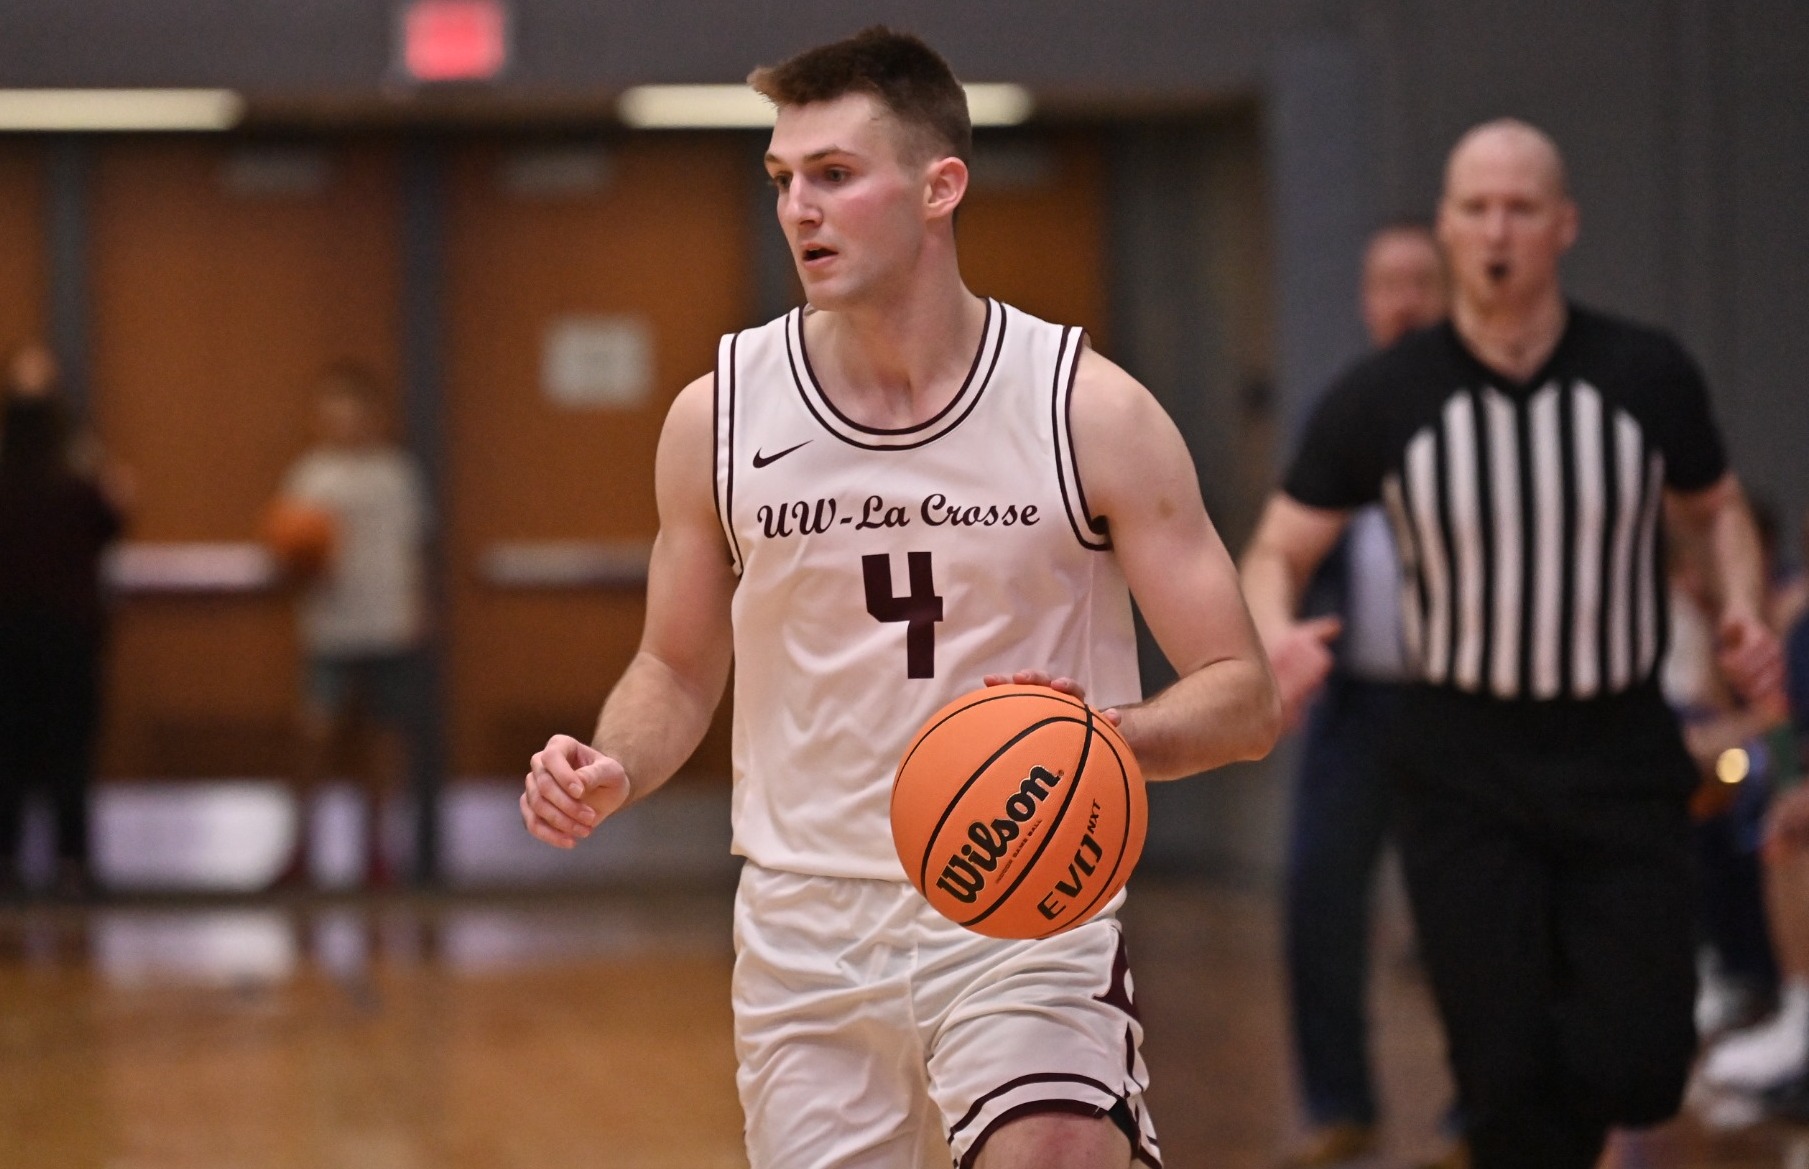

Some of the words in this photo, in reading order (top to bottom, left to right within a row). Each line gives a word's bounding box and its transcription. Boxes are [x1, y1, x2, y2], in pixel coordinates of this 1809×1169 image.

[757, 495, 910, 539] UW-La
[920, 493, 1040, 527] Crosse
[861, 551, 943, 679] 4
[935, 765, 1060, 904] Wilson
[1037, 833, 1103, 920] EVO
[1087, 798, 1101, 834] NXT
